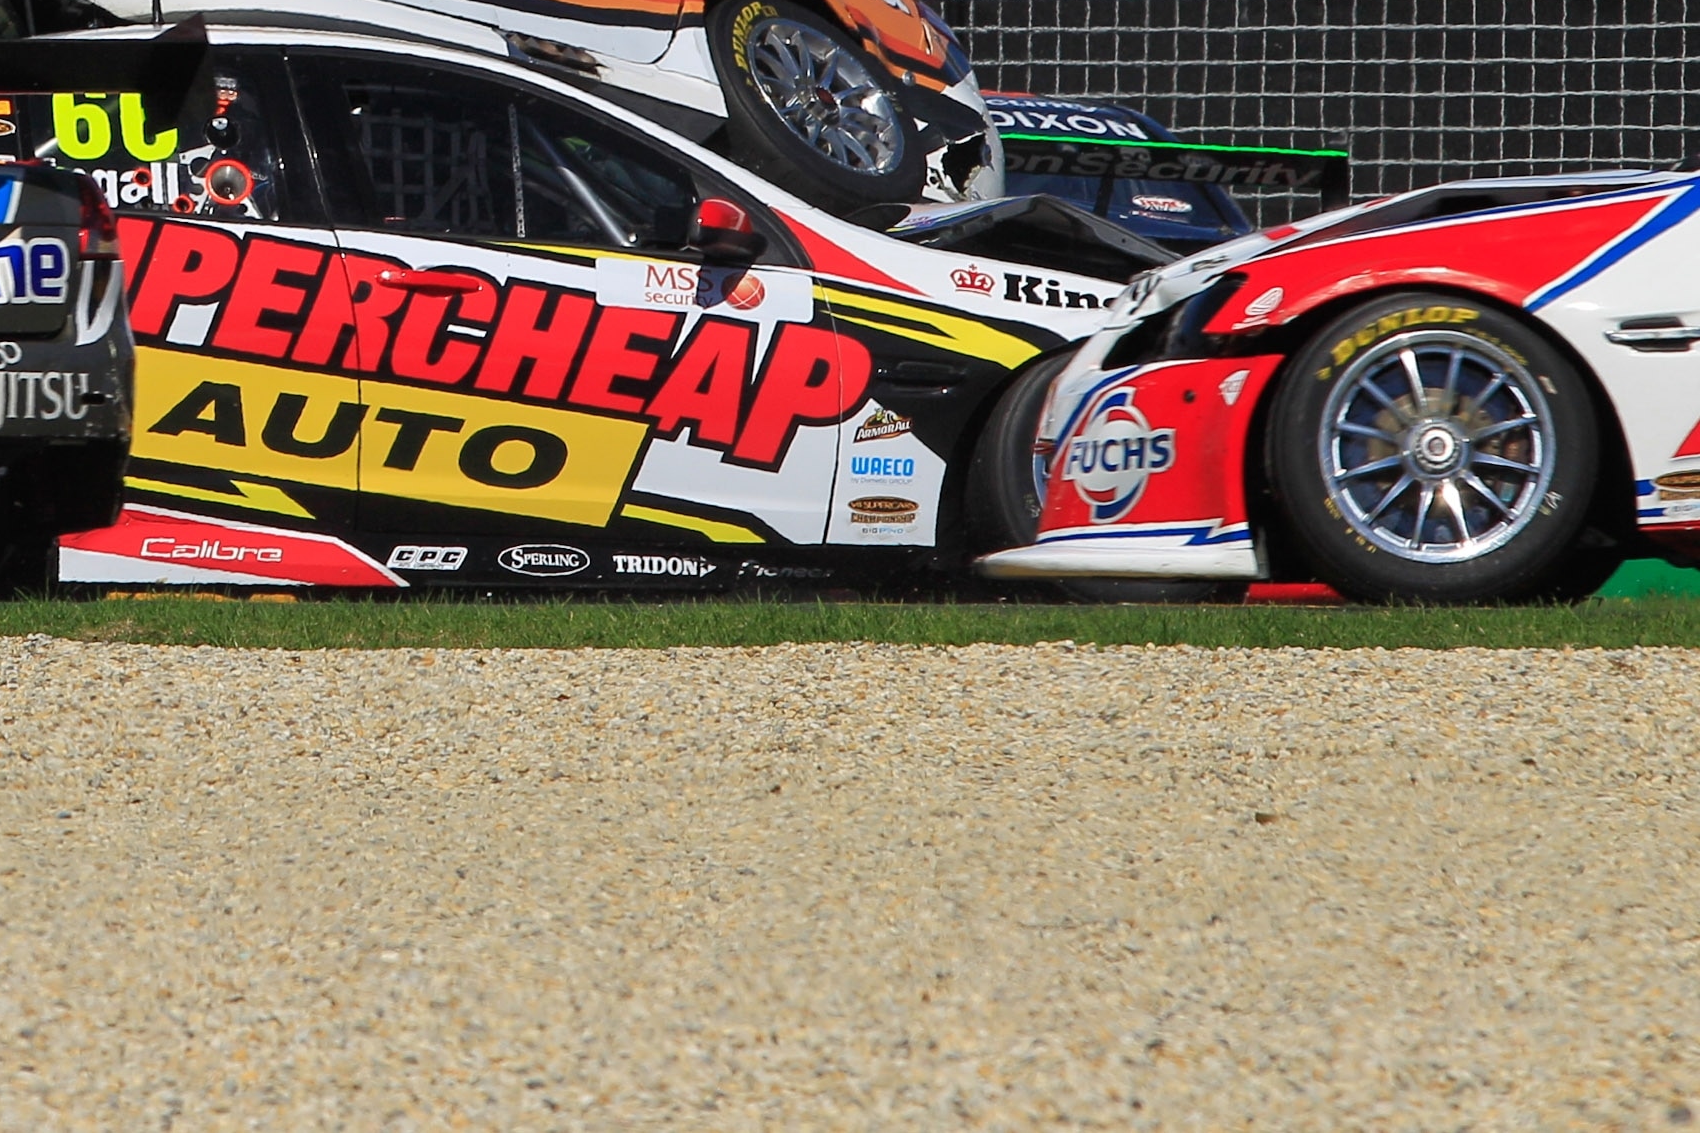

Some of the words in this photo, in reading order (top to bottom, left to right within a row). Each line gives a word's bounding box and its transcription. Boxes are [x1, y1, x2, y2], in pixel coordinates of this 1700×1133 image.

[733, 2, 762, 71] DUNLOP
[644, 264, 714, 292] MSS
[643, 291, 714, 306] security
[115, 217, 872, 464] UPERCHEAP
[1331, 306, 1479, 366] DUNLOP
[148, 379, 570, 491] AUTO
[851, 456, 915, 476] WAECO
[1067, 433, 1170, 474] FUCHS
[140, 537, 284, 563] Calibre
[511, 549, 580, 568] SPERLING
[613, 554, 699, 576] TRIDON
